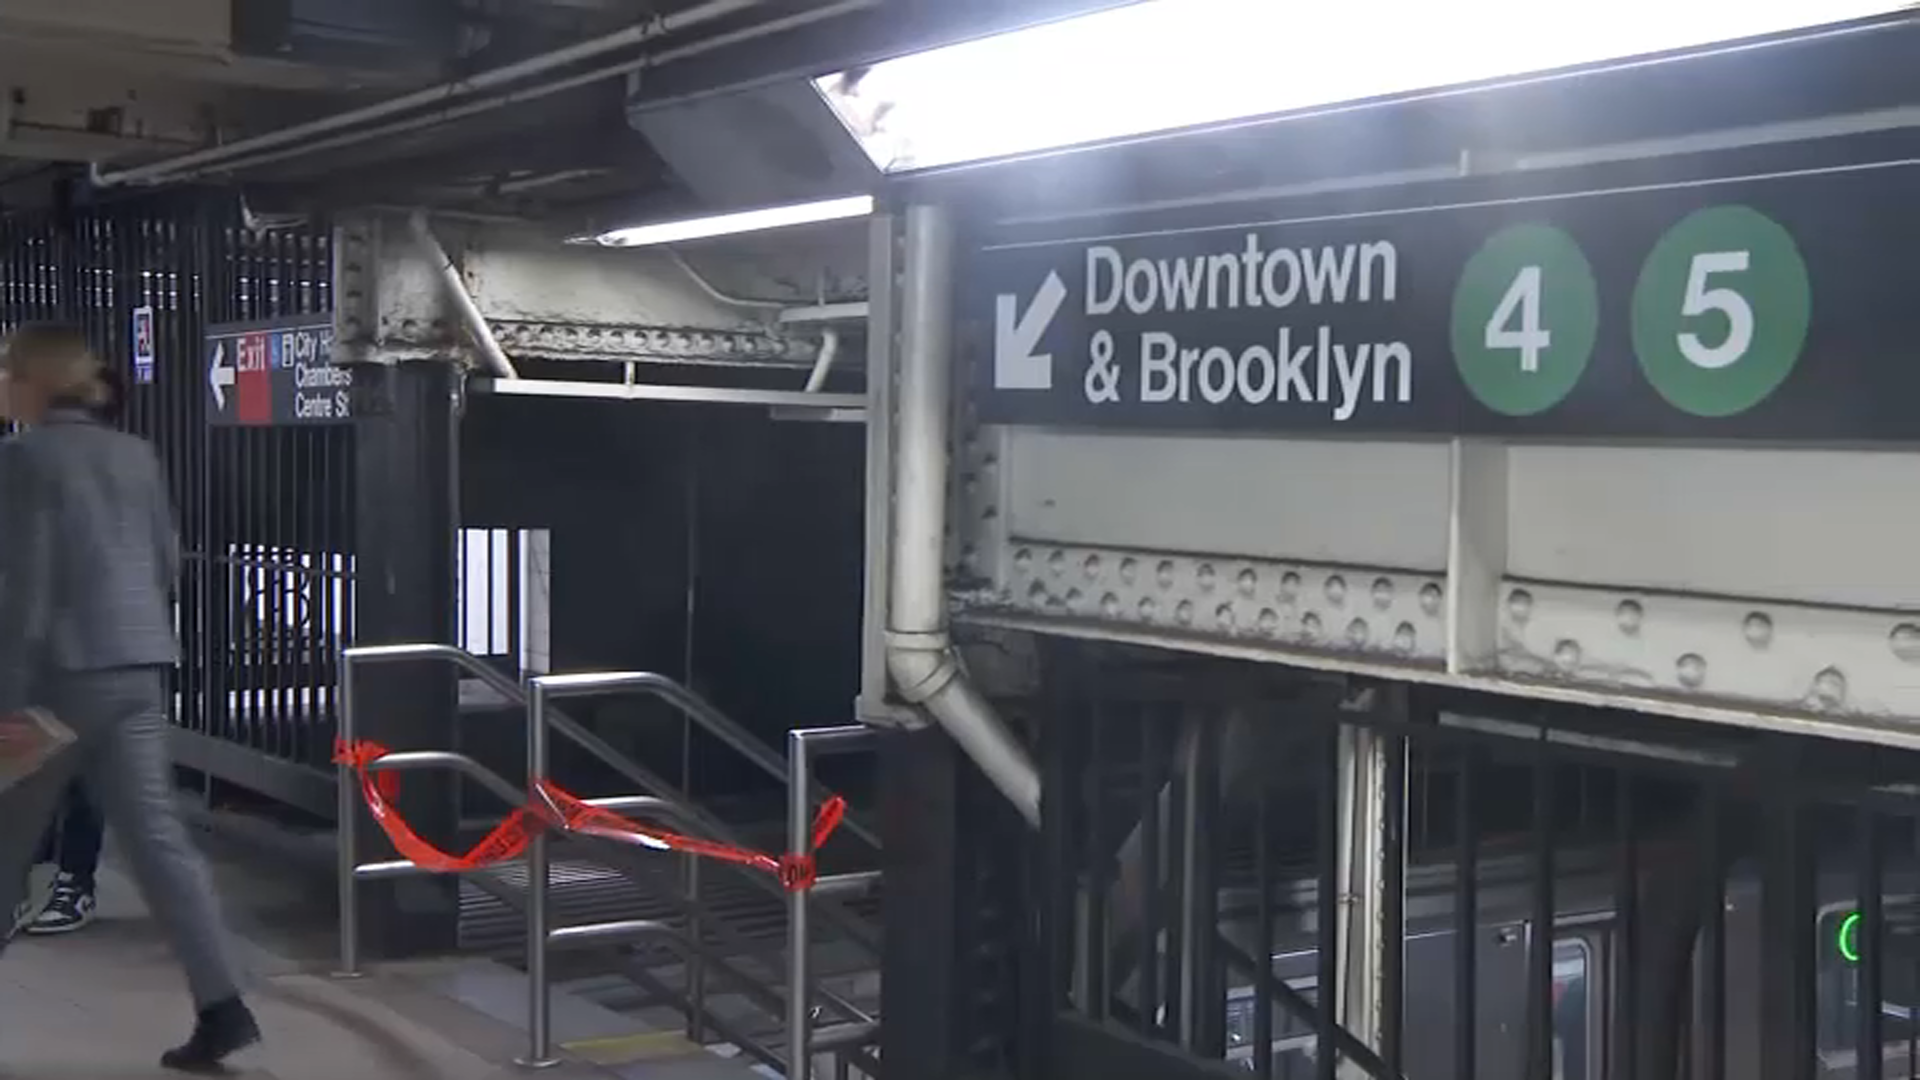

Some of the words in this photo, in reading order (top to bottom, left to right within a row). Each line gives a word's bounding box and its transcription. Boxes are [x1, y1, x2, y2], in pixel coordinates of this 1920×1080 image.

[1086, 233, 1397, 316] Downtown
[1485, 264, 1551, 373] 4
[1676, 249, 1754, 369] 5
[237, 335, 266, 372] Exit
[295, 331, 318, 362] City
[295, 361, 353, 389] Chambers
[1084, 329, 1120, 404] &
[1140, 325, 1413, 421] Brooklyn
[295, 391, 332, 418] Centre
